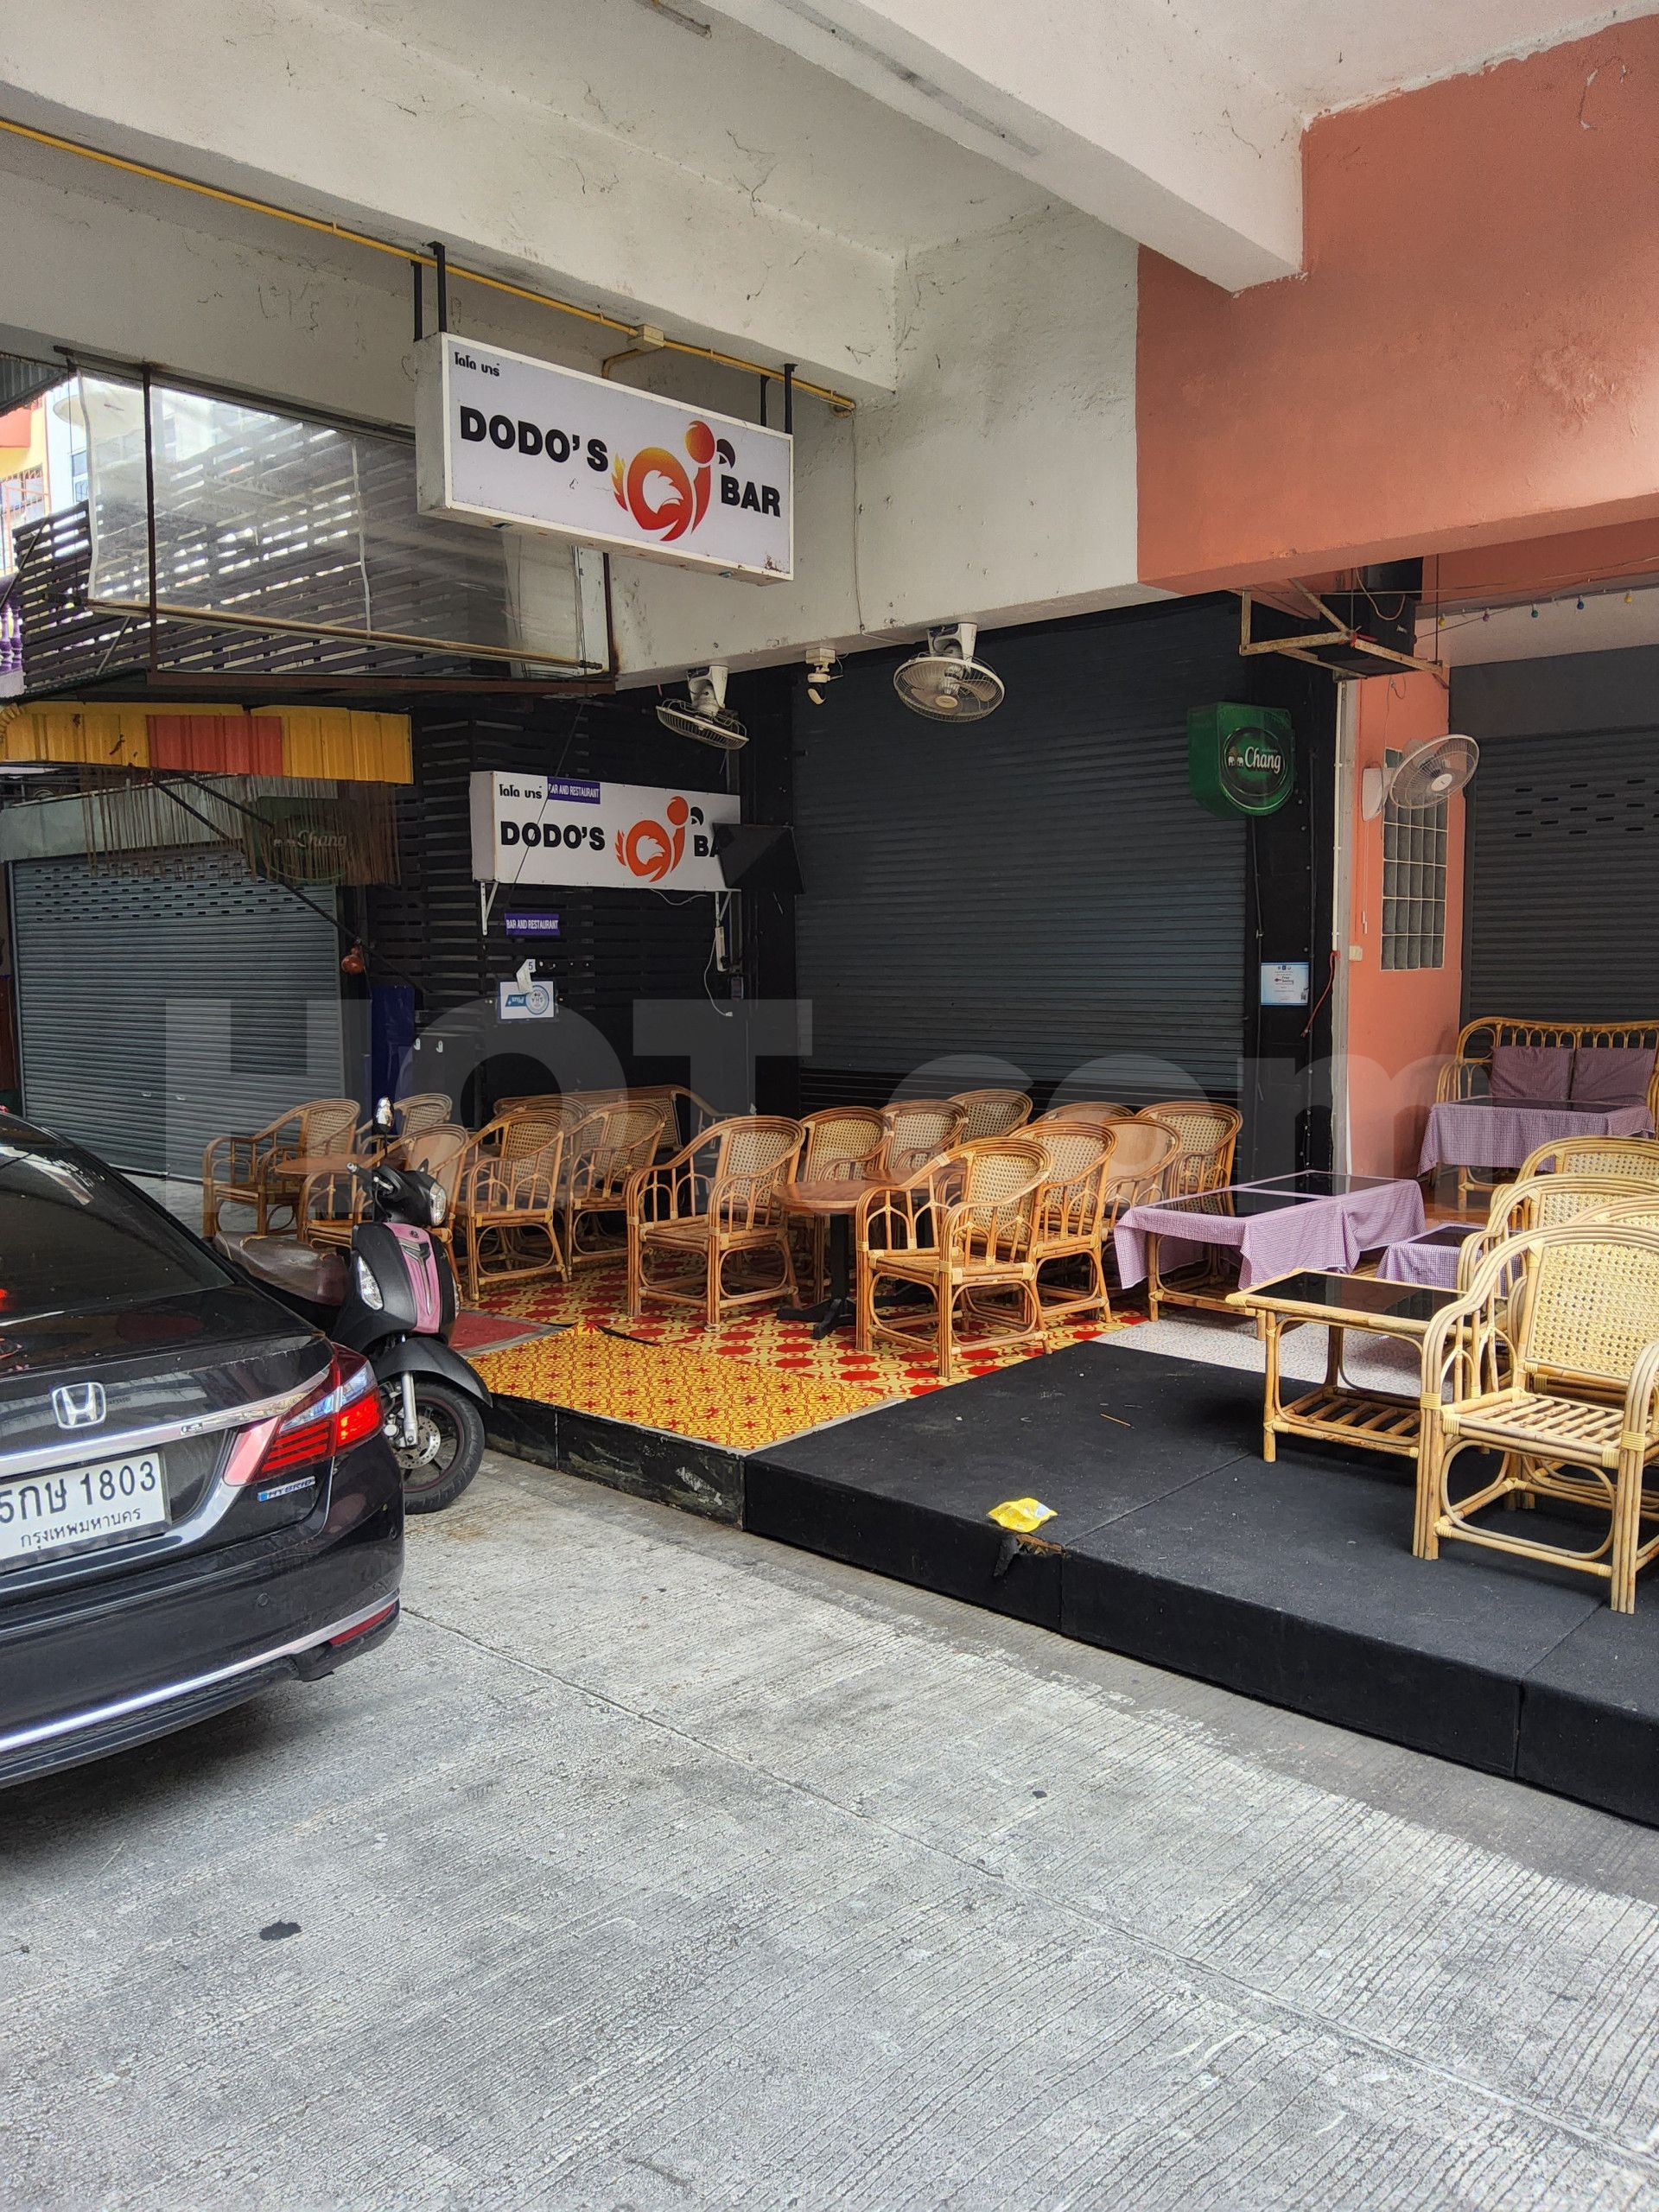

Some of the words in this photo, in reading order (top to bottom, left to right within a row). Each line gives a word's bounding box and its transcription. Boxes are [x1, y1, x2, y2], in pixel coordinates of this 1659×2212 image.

[460, 404, 608, 472] DODO'S
[721, 474, 781, 518] BAR
[1244, 746, 1282, 774] Chang
[558, 785, 569, 795] AND
[569, 785, 600, 798] RESTAURANT
[500, 821, 605, 850] DODO'S
[505, 919, 517, 930] BAR
[517, 919, 528, 930] AND
[528, 919, 558, 930] RESTAURANT
[528, 961, 533, 970] 5
[79, 1460, 156, 1505] 1803
[268, 1478, 313, 1499] HYBRID
[21, 1508, 141, 1550] กรุงเทพมหานคร
